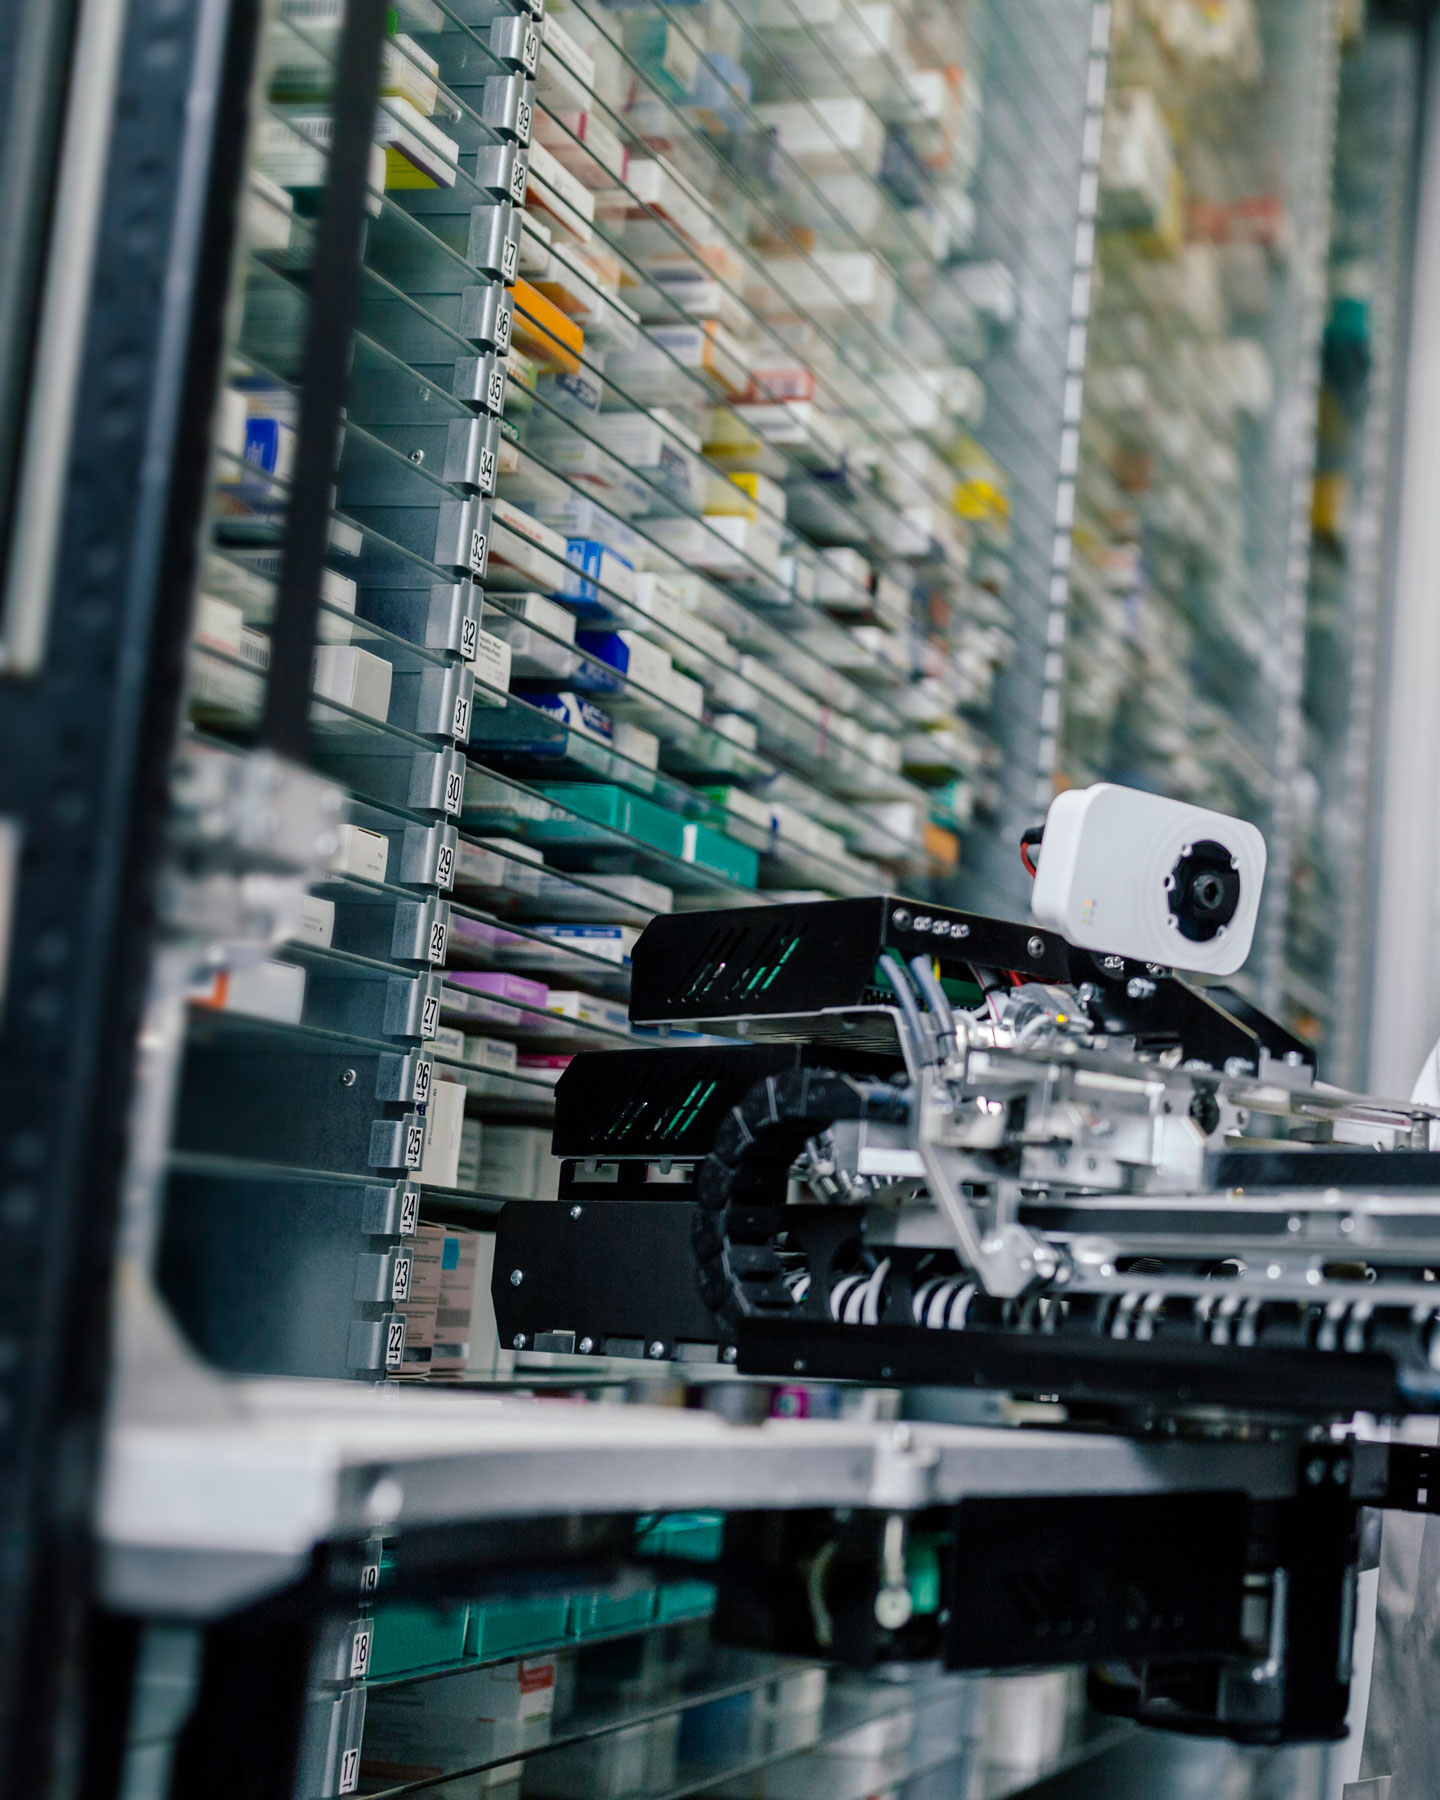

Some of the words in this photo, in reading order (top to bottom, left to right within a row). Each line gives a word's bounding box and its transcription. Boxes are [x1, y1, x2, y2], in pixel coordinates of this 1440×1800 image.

[525, 32, 537, 60] 40
[519, 101, 529, 130] 39
[513, 163, 524, 190] 38
[505, 240, 515, 266] 37
[498, 307, 508, 336] 36
[490, 373, 501, 400] 35
[481, 450, 493, 478] 34
[472, 533, 484, 560] 33
[463, 619, 475, 647] 32
[455, 699, 467, 726] 31
[447, 773, 460, 802] 30
[438, 847, 451, 875] 29
[431, 923, 444, 951] 28
[423, 997, 437, 1024] 27
[415, 1062, 430, 1090] 26
[408, 1127, 421, 1155] 25
[403, 1195, 416, 1222] 24
[395, 1260, 408, 1287] 23
[389, 1325, 402, 1352] 22
[362, 1567, 376, 1589] 19
[355, 1635, 367, 1663] 18
[344, 1751, 357, 1780] 17
